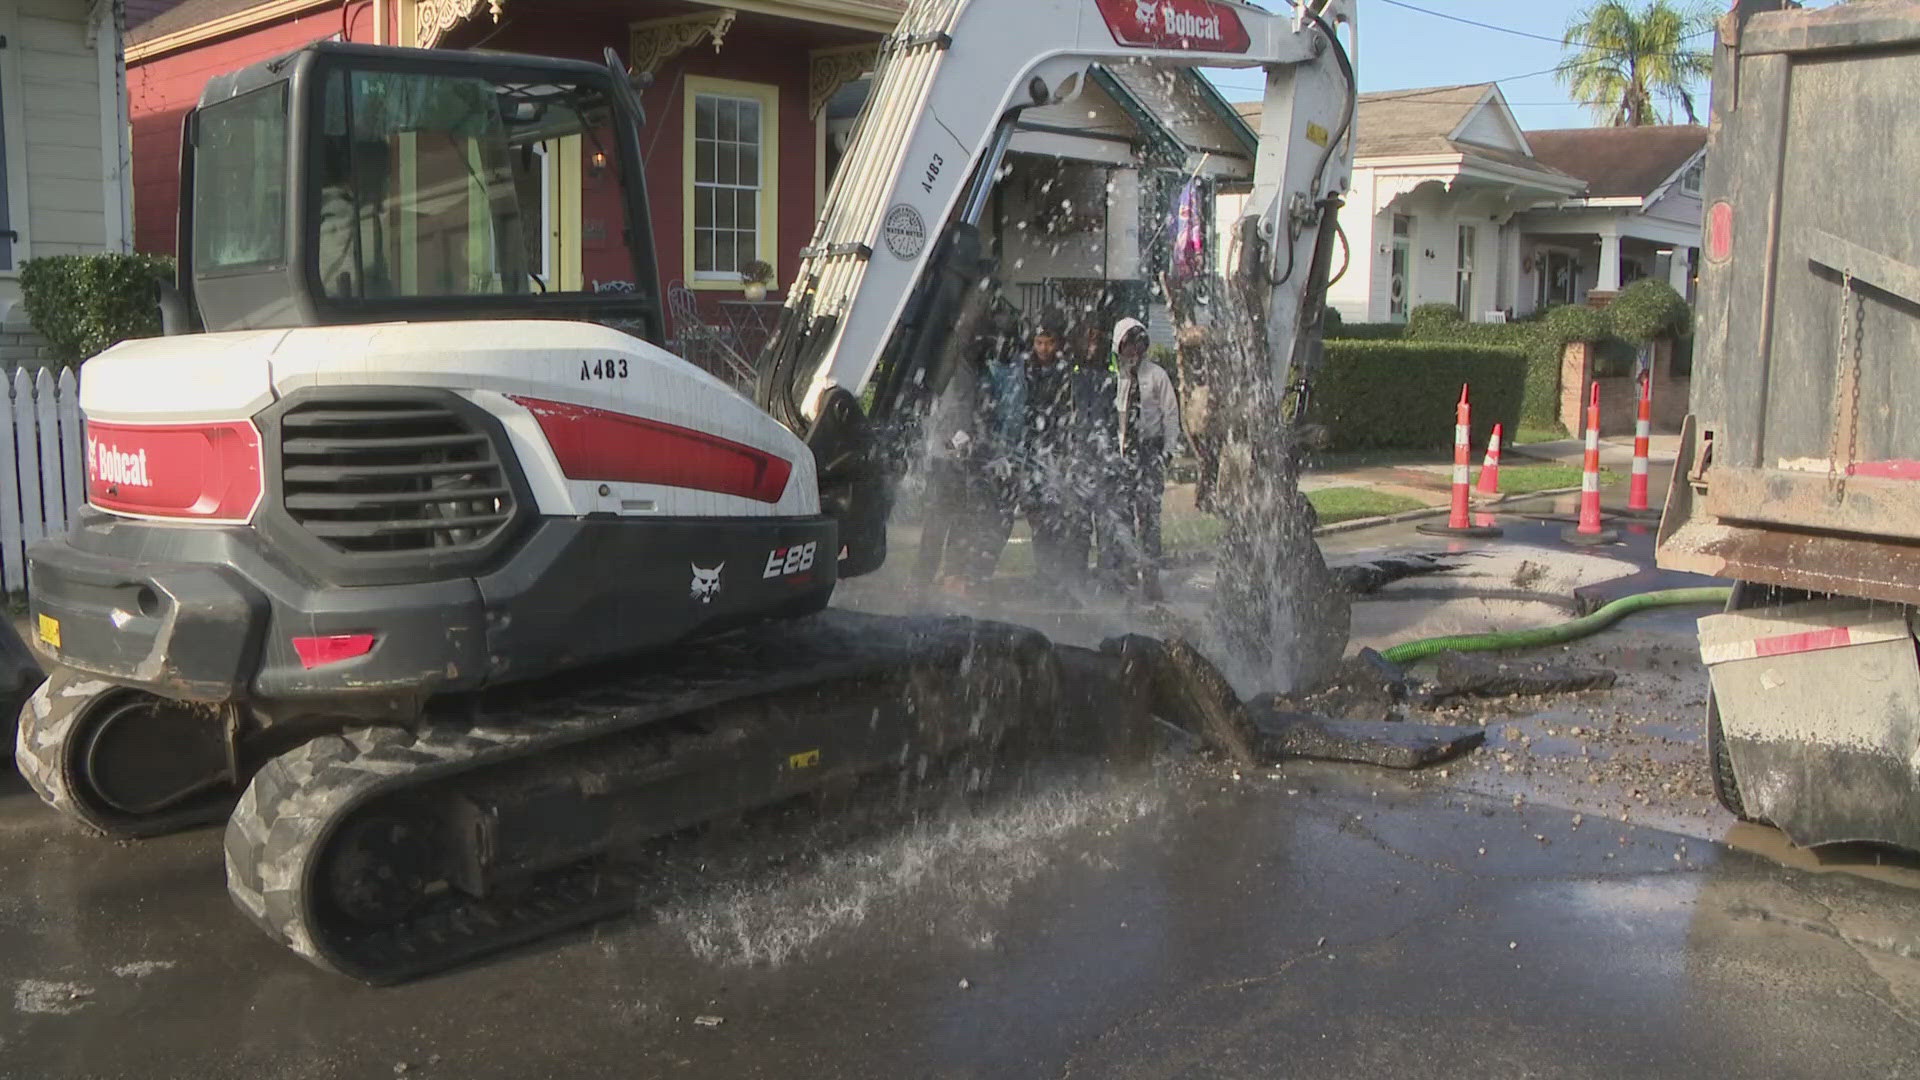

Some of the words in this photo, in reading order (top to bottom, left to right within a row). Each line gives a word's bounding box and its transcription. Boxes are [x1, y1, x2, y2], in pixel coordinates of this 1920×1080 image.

[1164, 10, 1220, 40] Bobcat
[921, 153, 944, 194] A483
[581, 358, 628, 381] A483
[99, 442, 148, 487] Bobcat
[763, 541, 817, 579] E88
